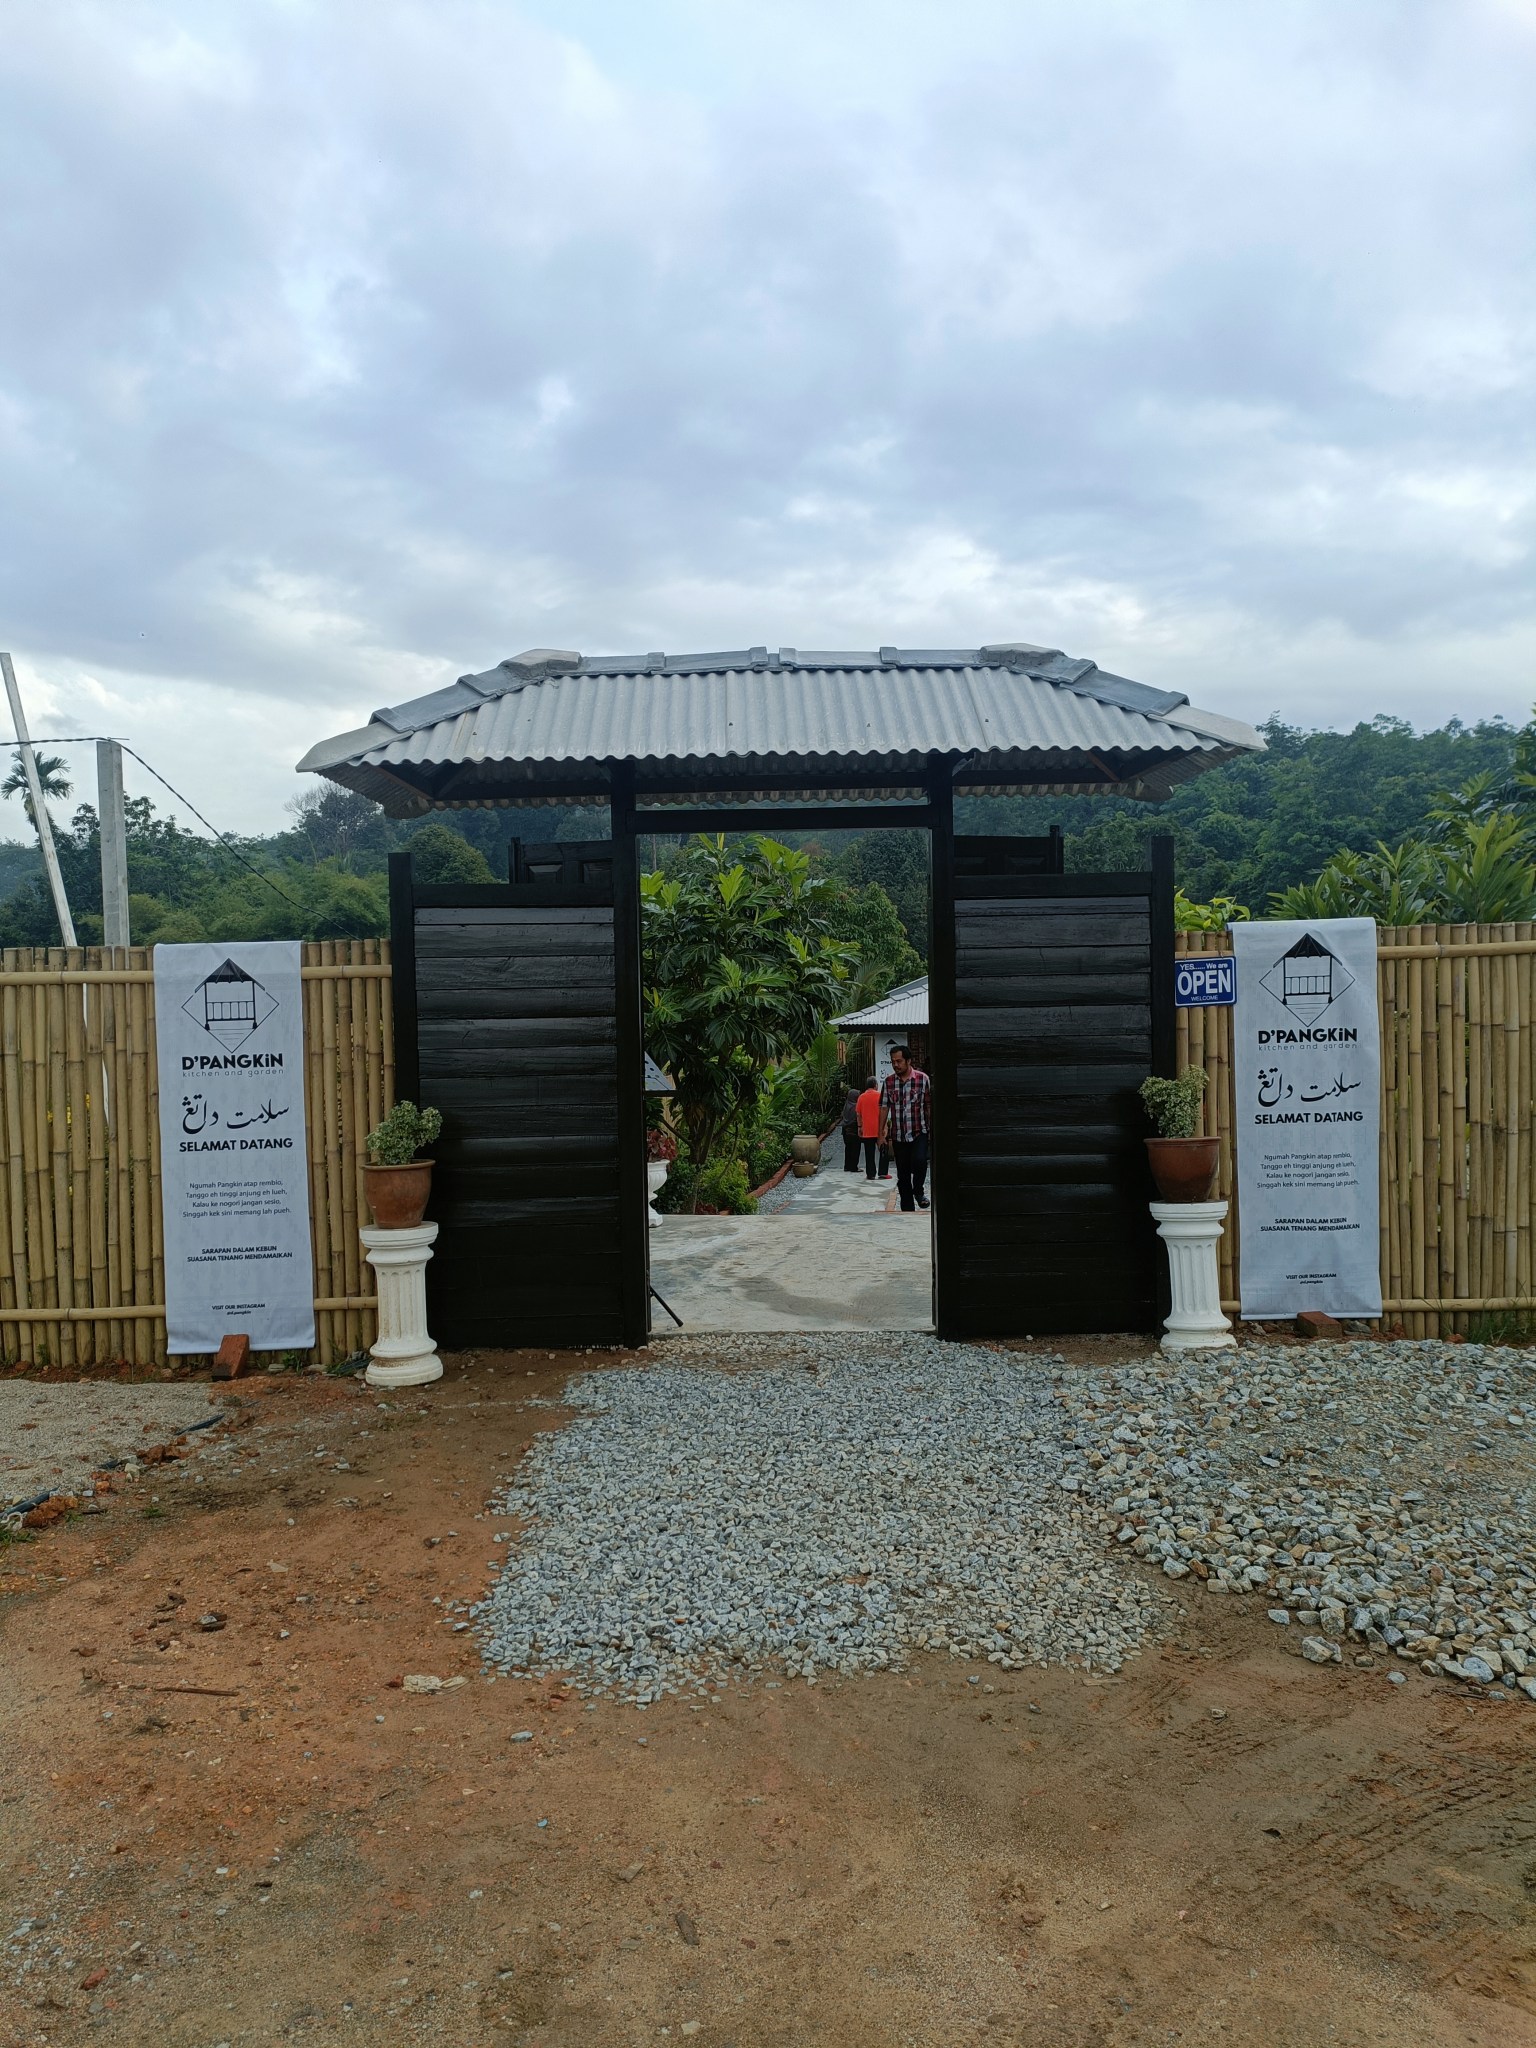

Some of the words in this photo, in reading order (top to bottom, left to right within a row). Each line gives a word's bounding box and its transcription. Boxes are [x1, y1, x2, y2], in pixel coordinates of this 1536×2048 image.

[1177, 969, 1231, 996] OPEN
[1323, 1043, 1357, 1052] garden
[182, 1069, 220, 1077] kitchen
[248, 1068, 284, 1077] garden
[1254, 1112, 1311, 1124] SELAMAT
[1314, 1111, 1363, 1123] DATANG
[179, 1140, 237, 1152] SELAMAT
[240, 1138, 293, 1150] DATANG
[1318, 1223, 1360, 1232] MENDAMAIKAN
[201, 1247, 232, 1255] SARAPAN
[244, 1252, 293, 1260] MENDAMAIKAN
